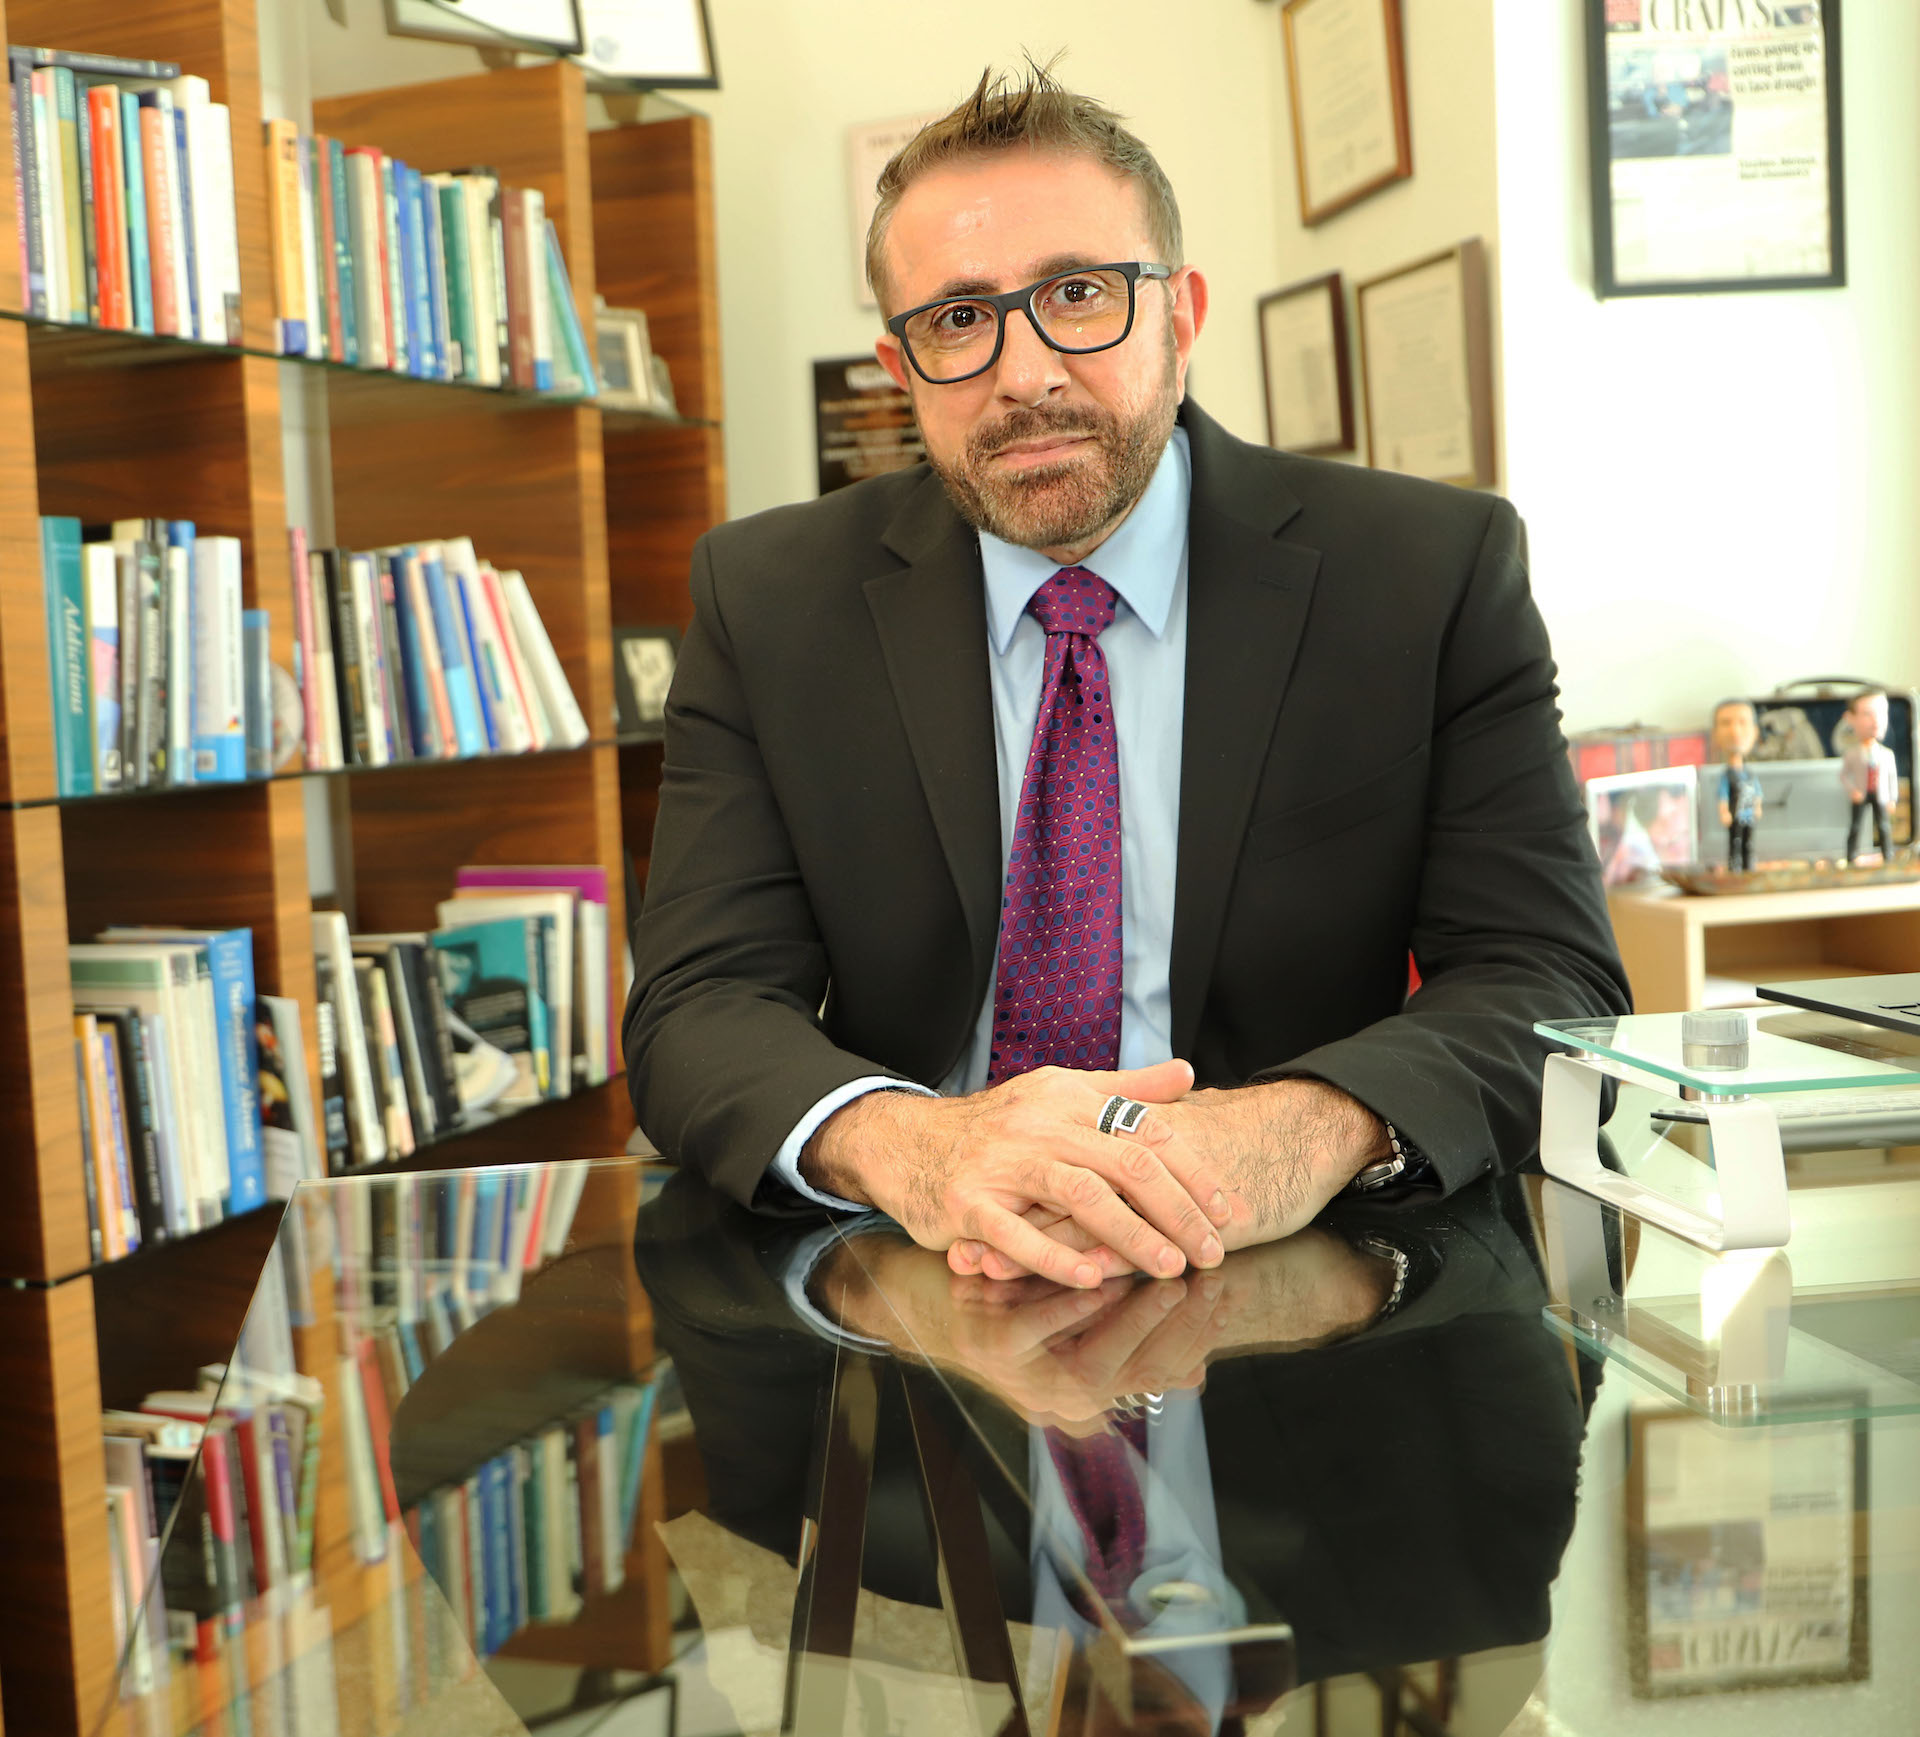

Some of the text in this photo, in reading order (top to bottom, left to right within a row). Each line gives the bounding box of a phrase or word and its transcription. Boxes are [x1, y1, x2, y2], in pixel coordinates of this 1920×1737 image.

[63, 594, 84, 715] Addictions
[229, 980, 250, 1084] Substance
[241, 1086, 256, 1151] Abuse
